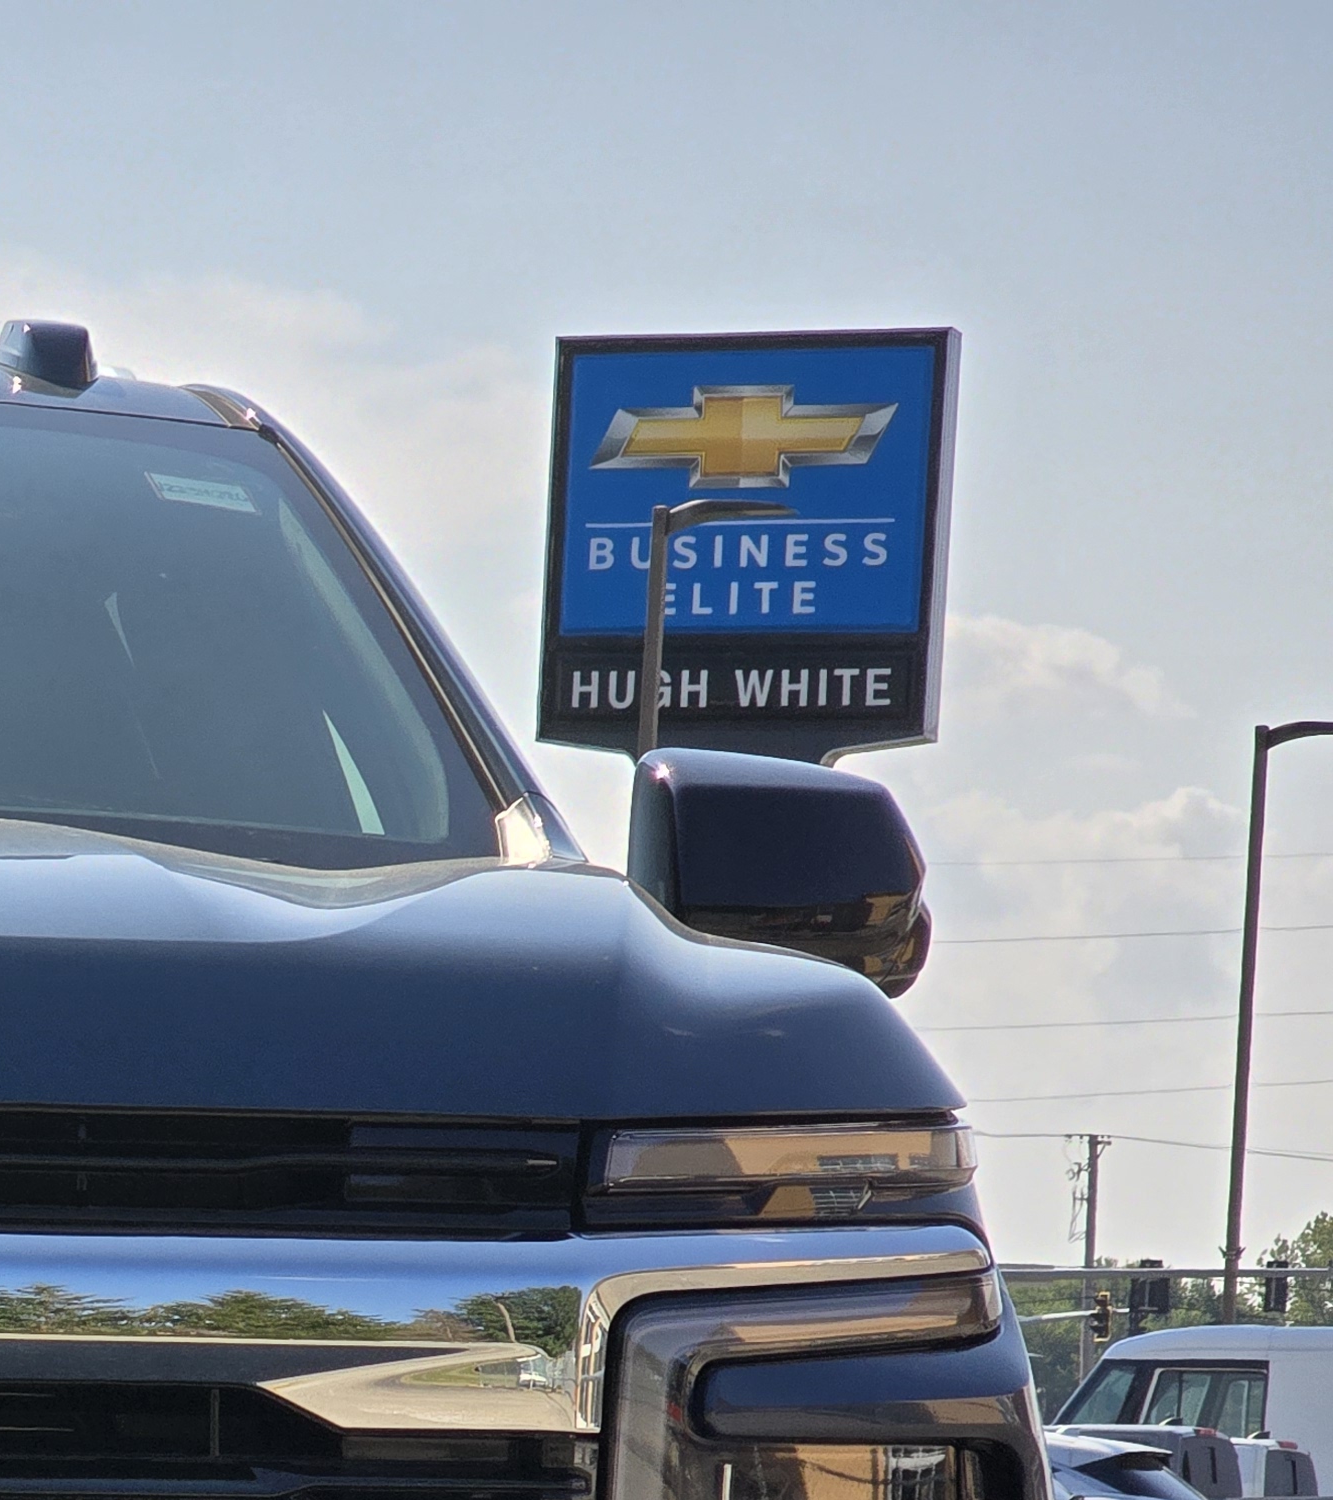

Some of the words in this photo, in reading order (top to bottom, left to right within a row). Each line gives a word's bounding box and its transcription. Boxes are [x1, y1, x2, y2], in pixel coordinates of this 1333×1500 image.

[588, 532, 889, 571] BUSINESS
[570, 669, 709, 710] HUGH
[734, 667, 892, 708] WHITE
